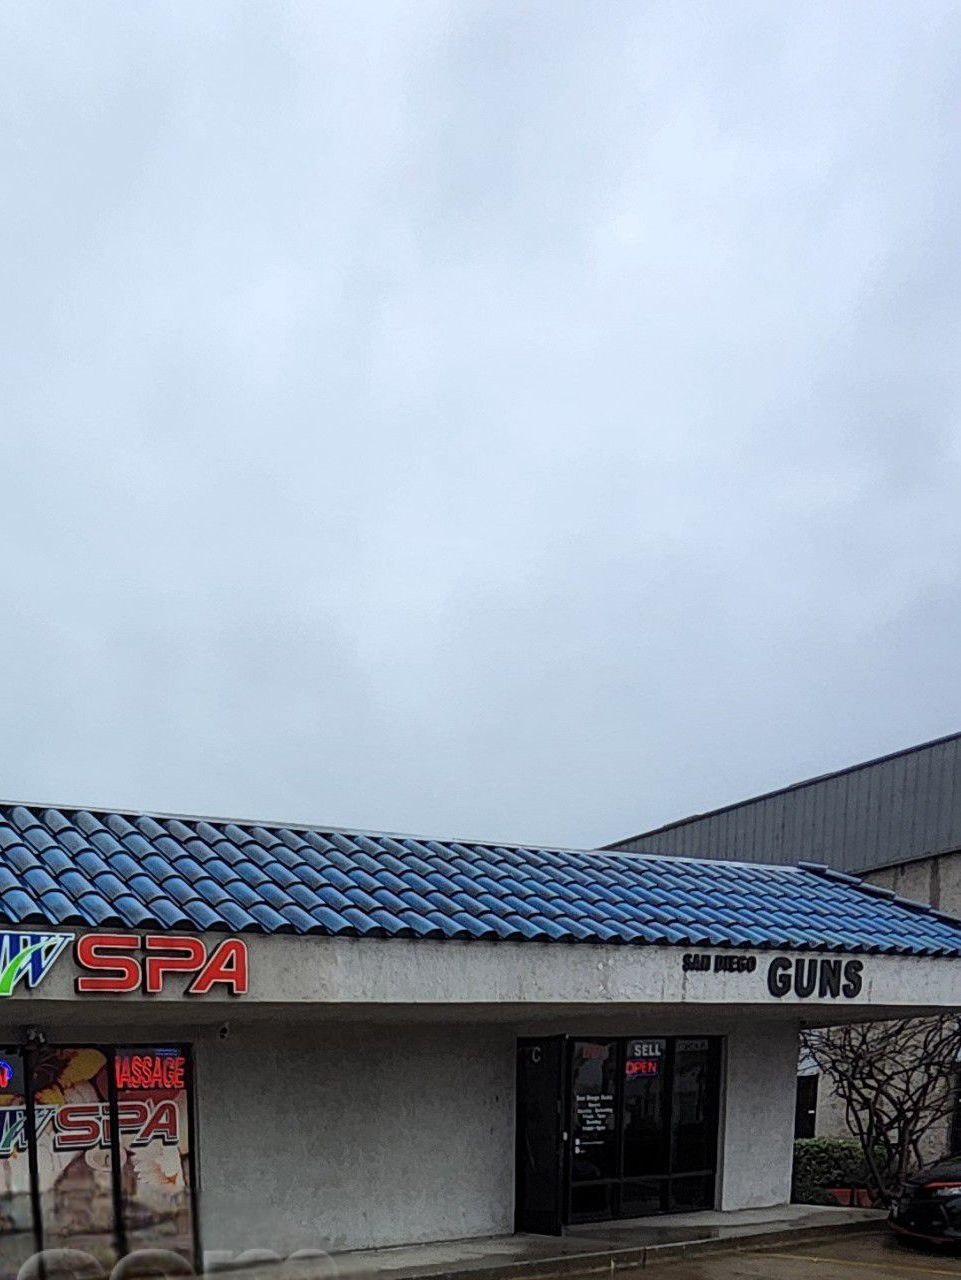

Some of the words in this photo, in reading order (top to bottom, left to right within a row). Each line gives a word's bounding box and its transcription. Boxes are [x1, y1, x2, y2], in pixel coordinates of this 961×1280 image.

[75, 933, 249, 994] SPA
[682, 954, 711, 972] SAN
[714, 955, 757, 973] DIEGO
[767, 956, 864, 998] GUNS
[532, 1047, 541, 1062] C
[634, 1044, 661, 1057] SELL
[626, 1061, 657, 1075] OPEN
